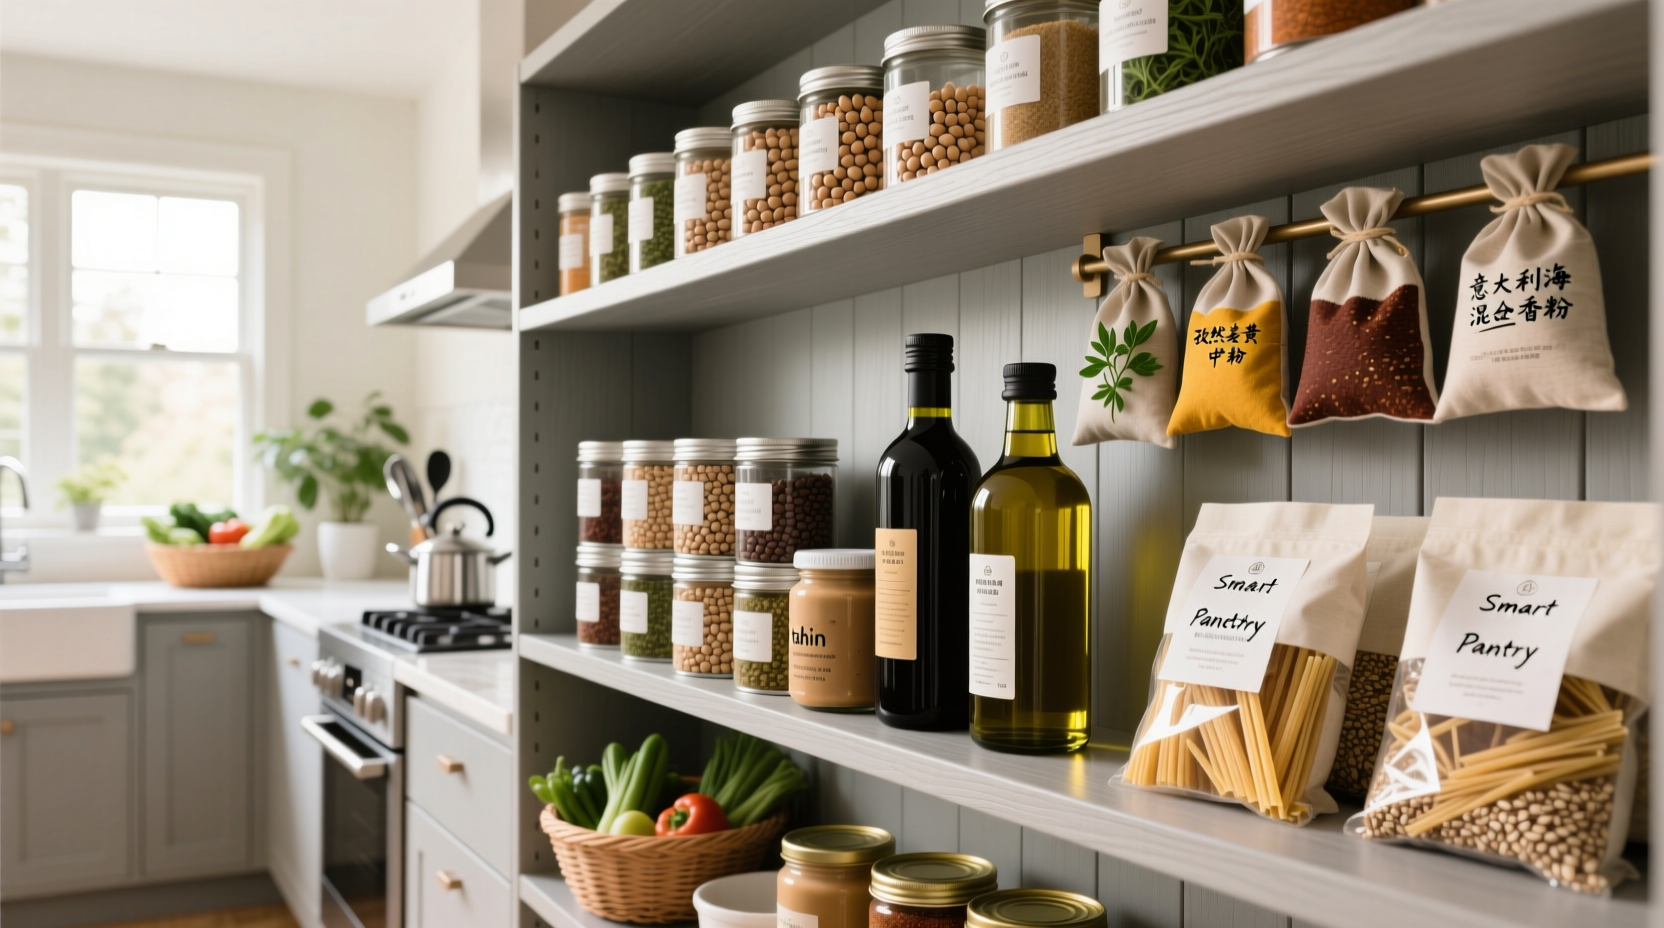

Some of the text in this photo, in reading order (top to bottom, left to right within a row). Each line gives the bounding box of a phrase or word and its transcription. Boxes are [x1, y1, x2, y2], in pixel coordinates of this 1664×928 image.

[1213, 574, 1278, 594] Smart
[1479, 594, 1559, 616] Smart
[1456, 632, 1539, 669] Pantry
